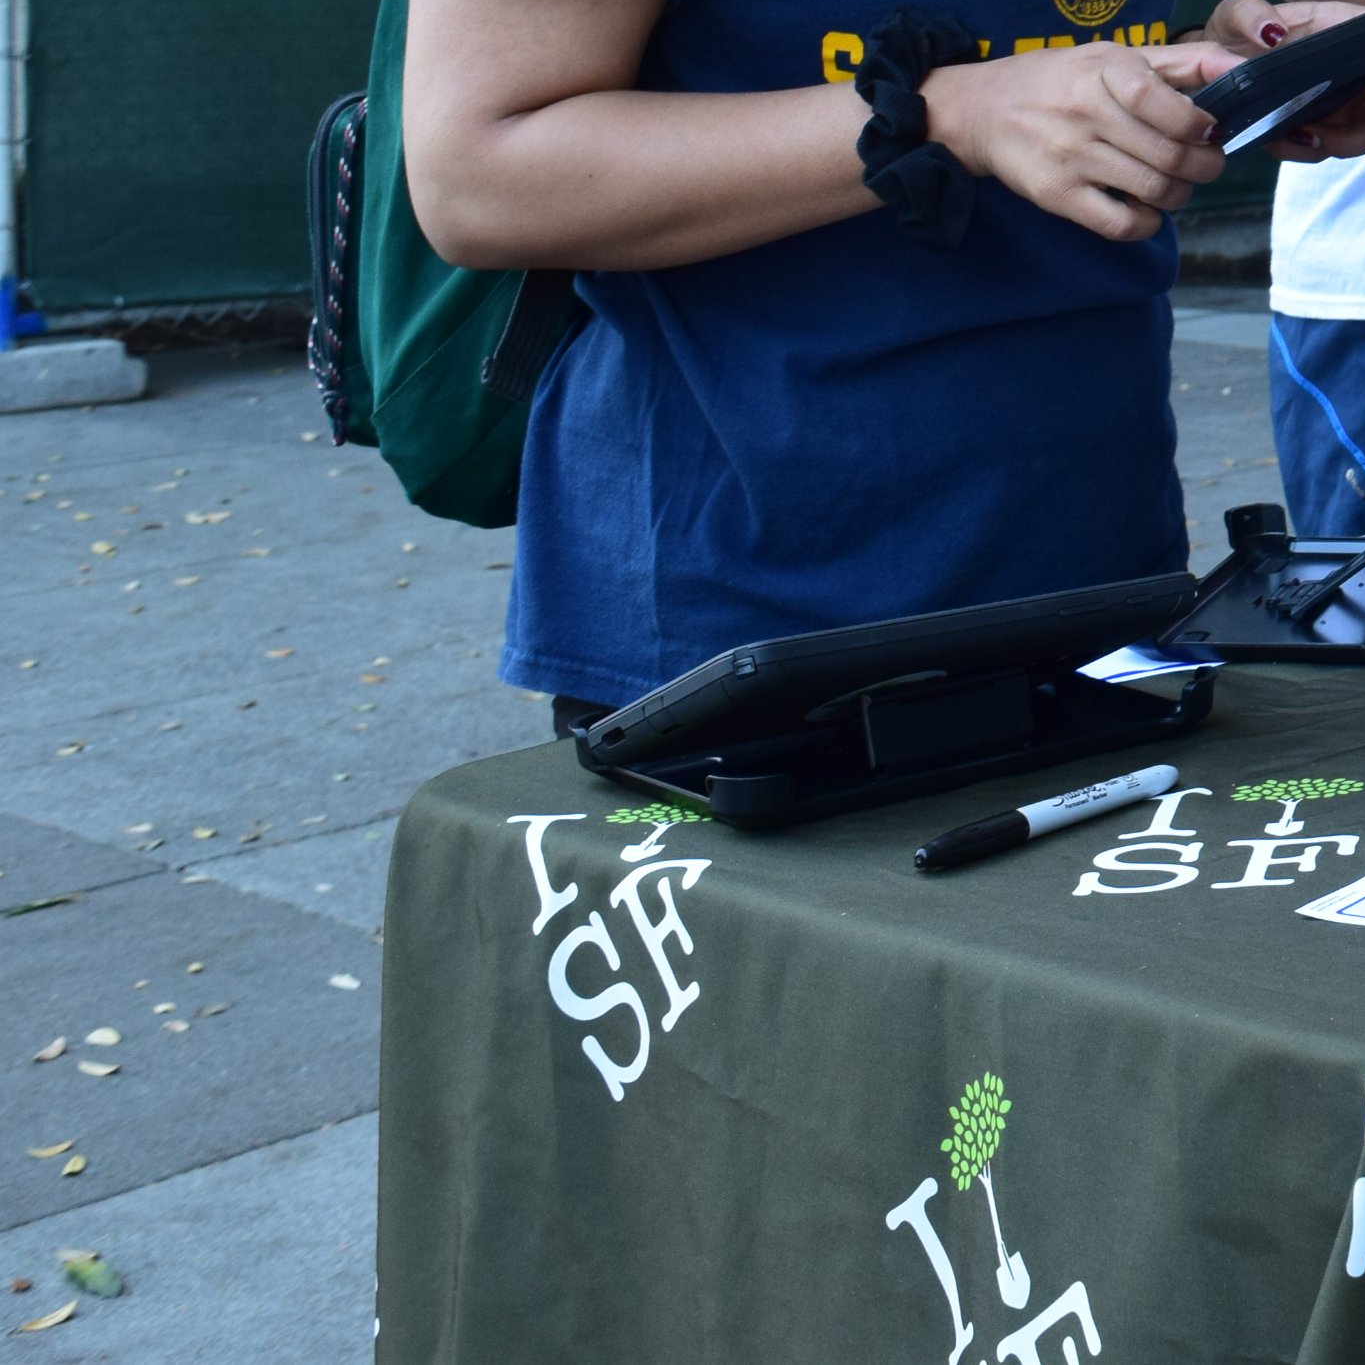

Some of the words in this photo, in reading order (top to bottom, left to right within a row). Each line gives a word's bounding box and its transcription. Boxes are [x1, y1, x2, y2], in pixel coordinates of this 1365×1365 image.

[1118, 787, 1213, 840] I
[507, 814, 588, 935] I
[1072, 833, 1360, 896] SF
[547, 858, 712, 1102] SF
